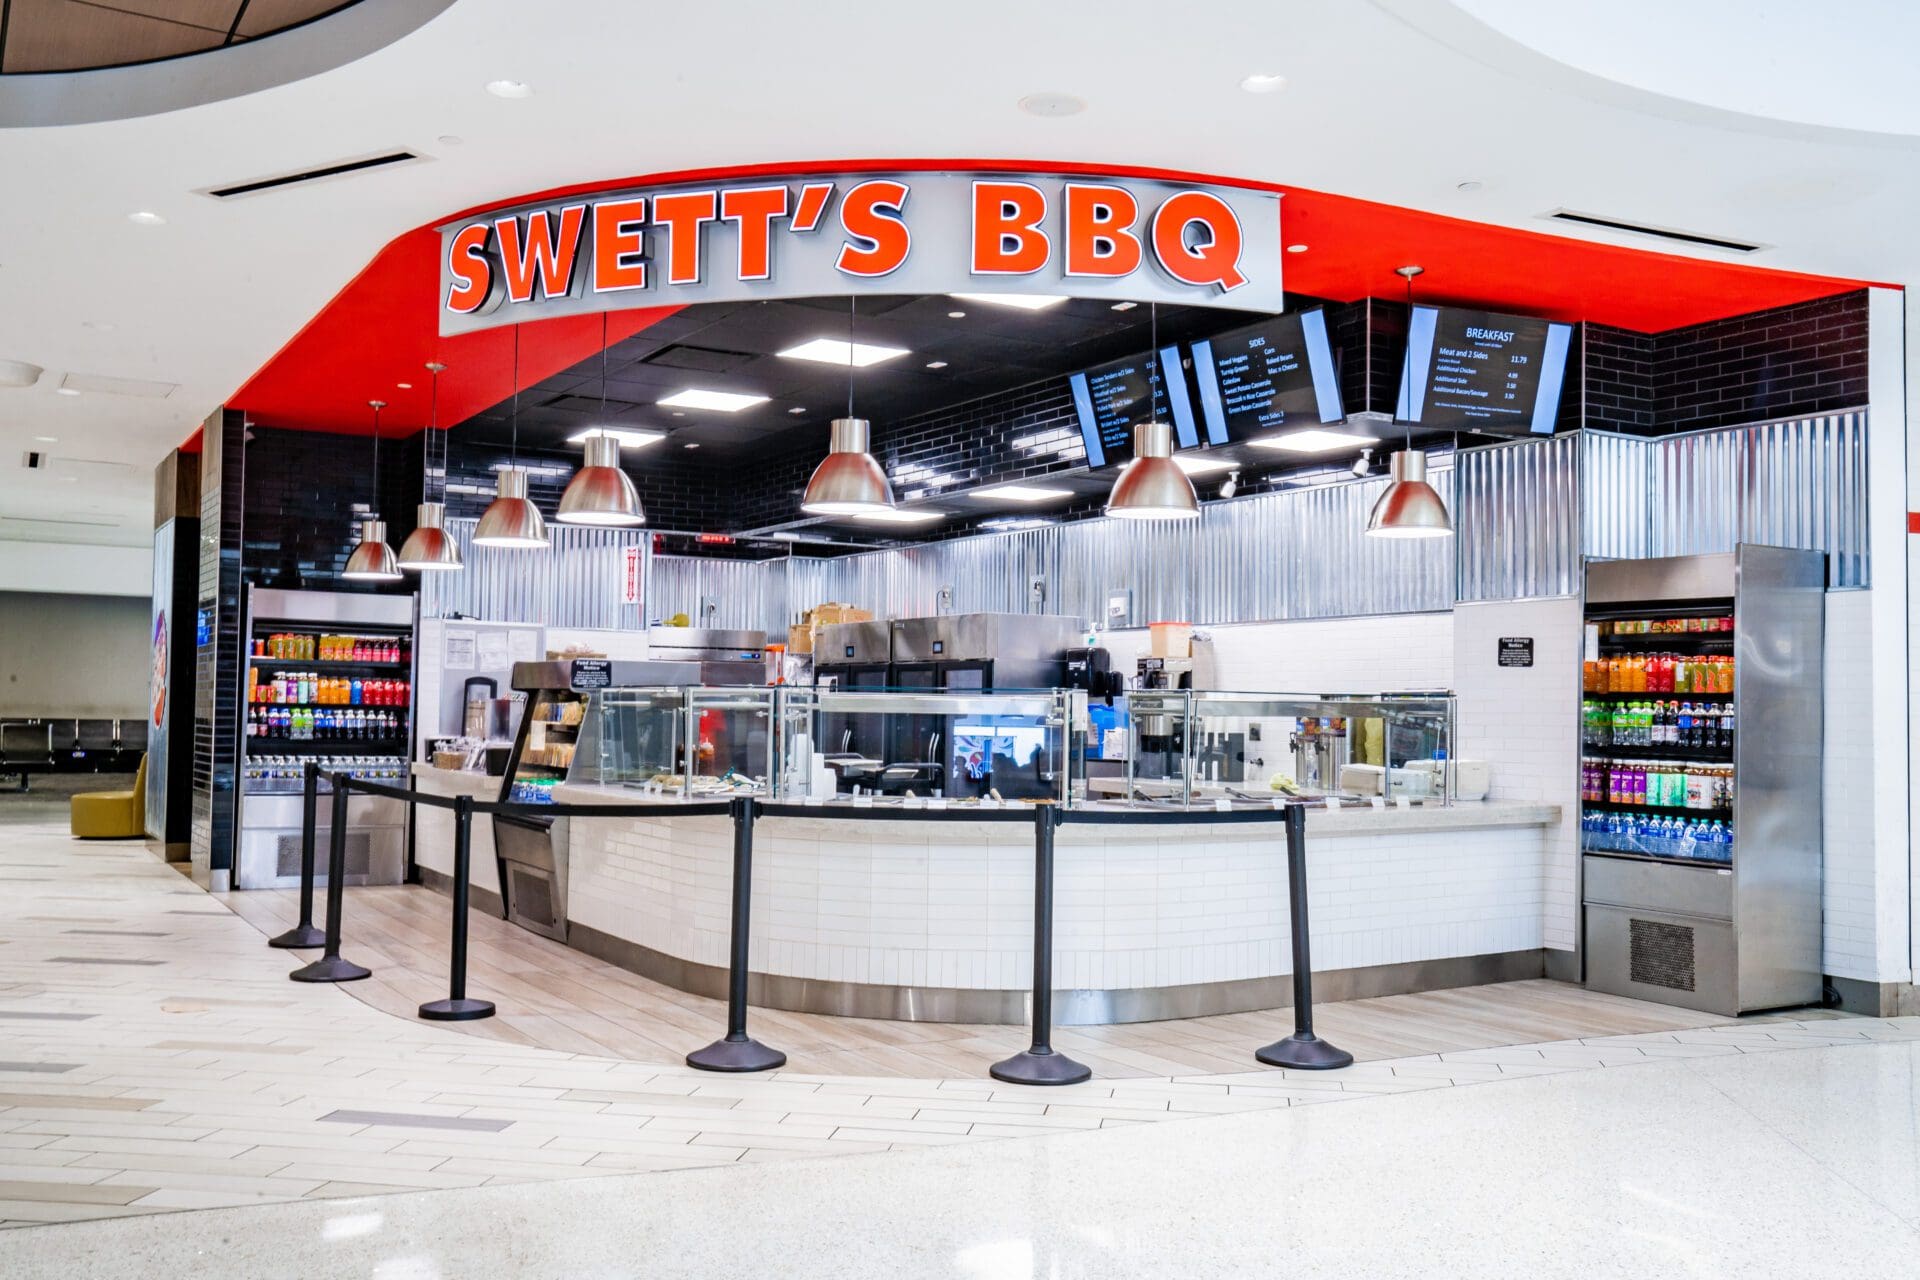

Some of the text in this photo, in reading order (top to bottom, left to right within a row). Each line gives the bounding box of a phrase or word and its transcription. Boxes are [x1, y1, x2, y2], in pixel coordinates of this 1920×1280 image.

[445, 179, 1251, 314] SWETT'S BBQ
[1466, 327, 1515, 342] BREAKFAST
[1249, 337, 1265, 348] SIDES
[1440, 348, 1456, 356] Meat
[1282, 363, 1298, 371] Cheese
